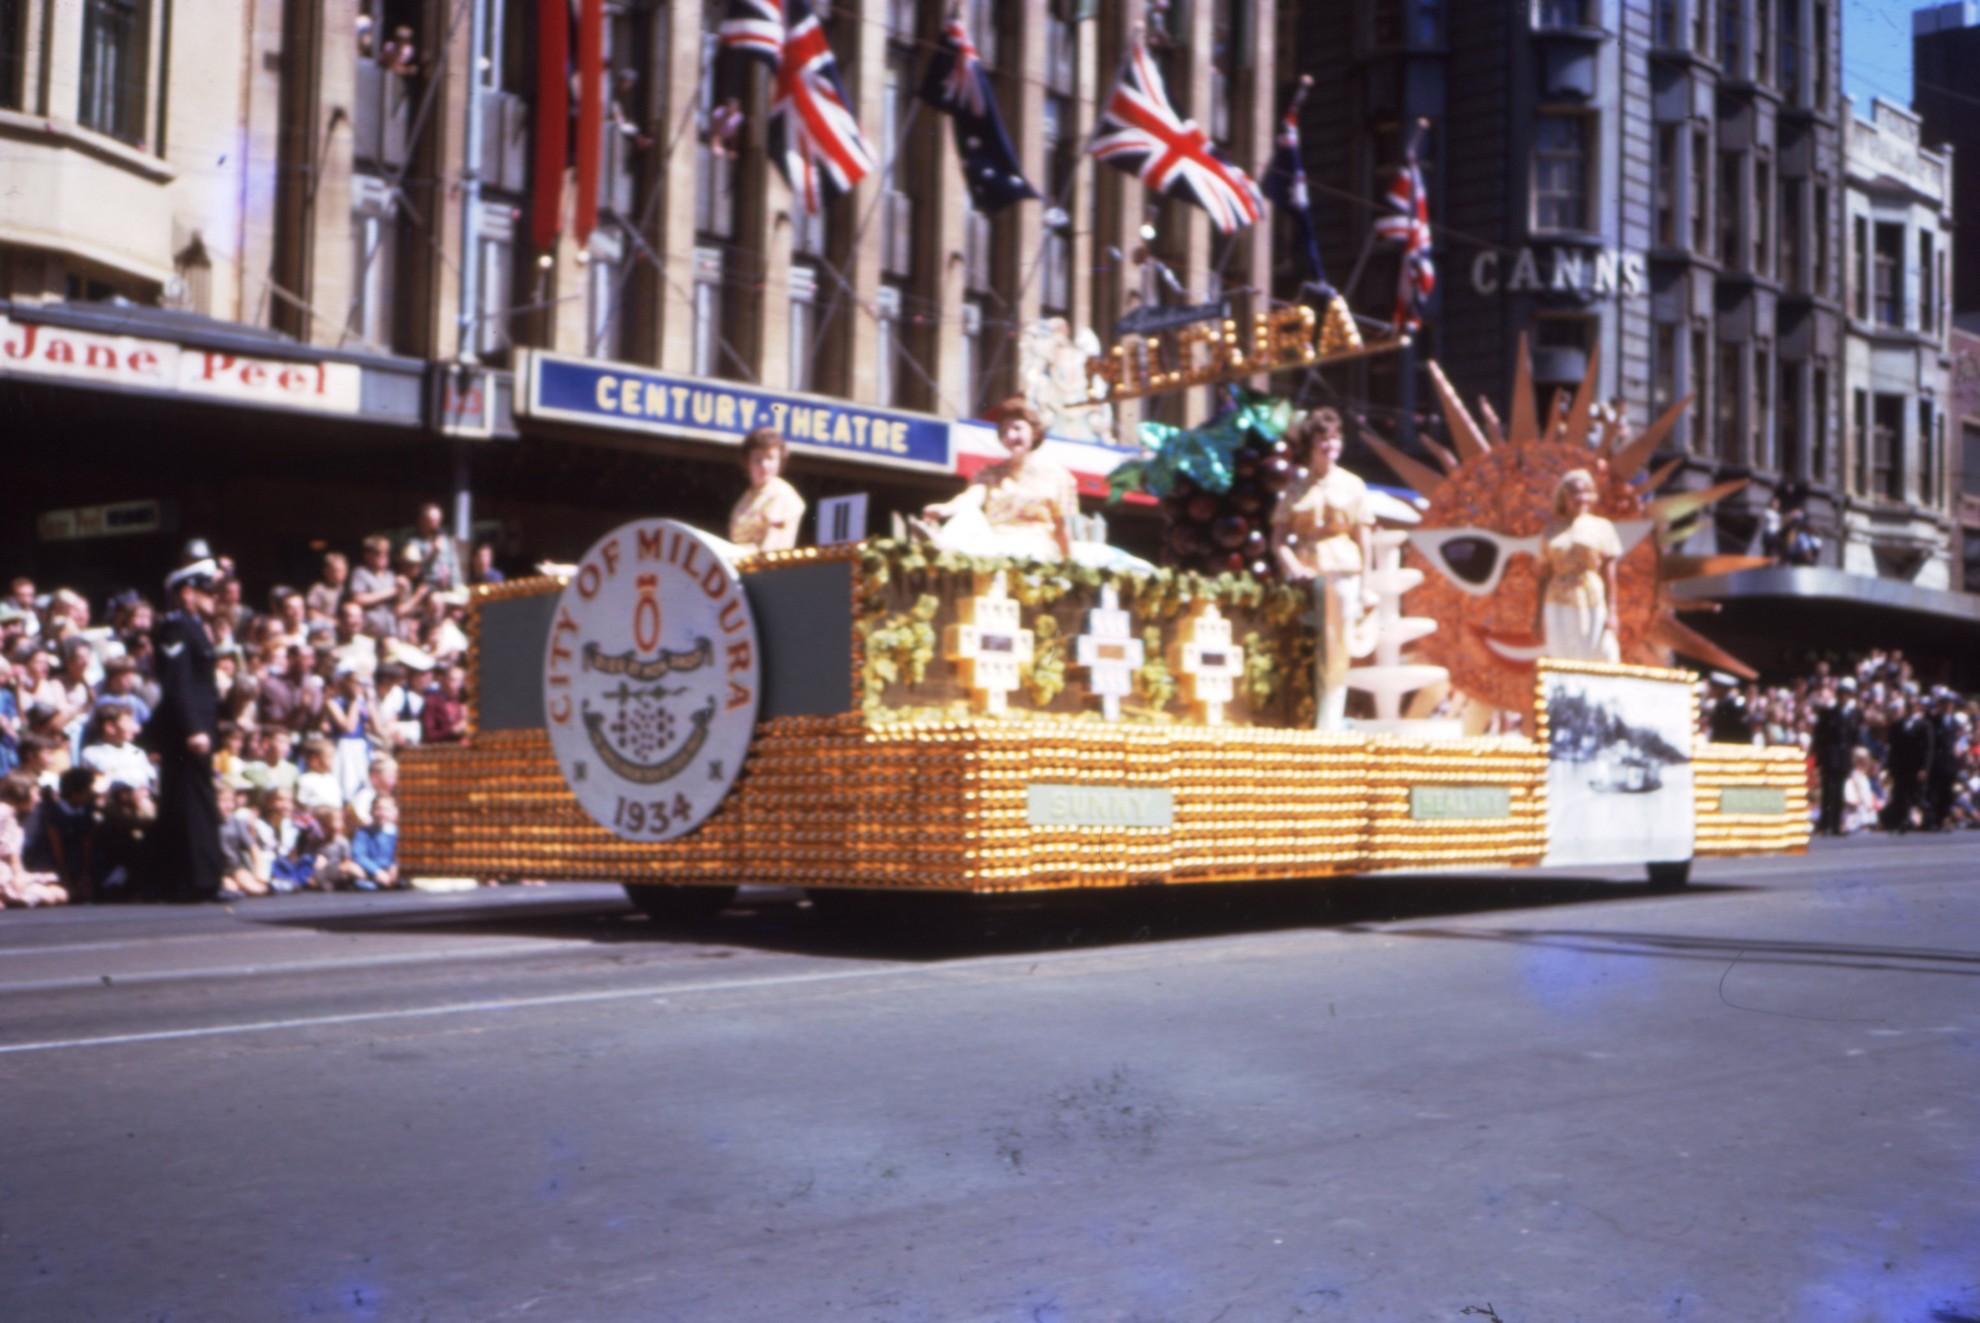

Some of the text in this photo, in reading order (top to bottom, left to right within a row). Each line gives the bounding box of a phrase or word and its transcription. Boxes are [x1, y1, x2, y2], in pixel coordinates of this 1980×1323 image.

[1471, 246, 1645, 296] CANNS
[3, 324, 327, 394] Jane Peel
[595, 375, 910, 454] CENTURY THEATRE
[549, 526, 752, 726] CITY OF MILDURA
[613, 791, 692, 835] 1934
